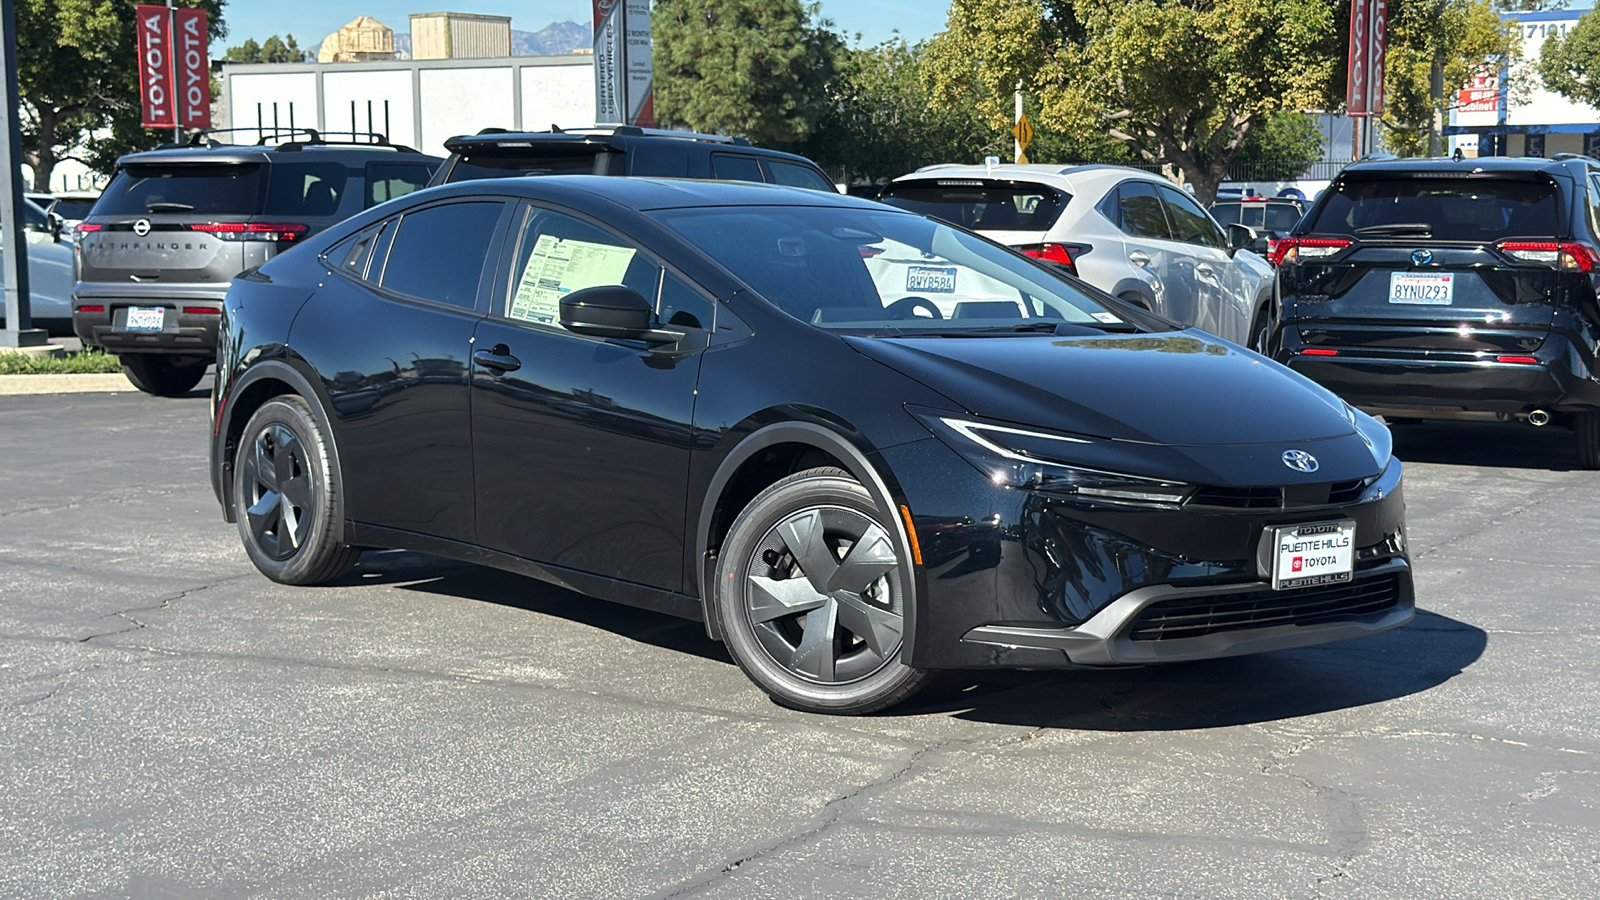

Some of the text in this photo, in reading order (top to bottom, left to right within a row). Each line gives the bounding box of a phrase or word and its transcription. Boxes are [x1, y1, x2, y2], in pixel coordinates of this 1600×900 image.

[606, 23, 614, 81] VEHICLES
[1352, 0, 1364, 107] TOYOT
[1373, 0, 1385, 107] TOYOT
[145, 14, 165, 121] TOYOTA
[184, 16, 203, 122] TOYOTA
[599, 53, 607, 114] CERTIFIED
[1459, 101, 1493, 111] Cabinet
[910, 276, 951, 288] 8WYB584
[1394, 284, 1449, 300] 8YNU293
[1300, 525, 1338, 534] TOYOTA
[1280, 537, 1349, 554] PUENTE HILLS
[1305, 556, 1337, 567] TOYOTA
[1280, 573, 1348, 588] PUENTE HILLS
